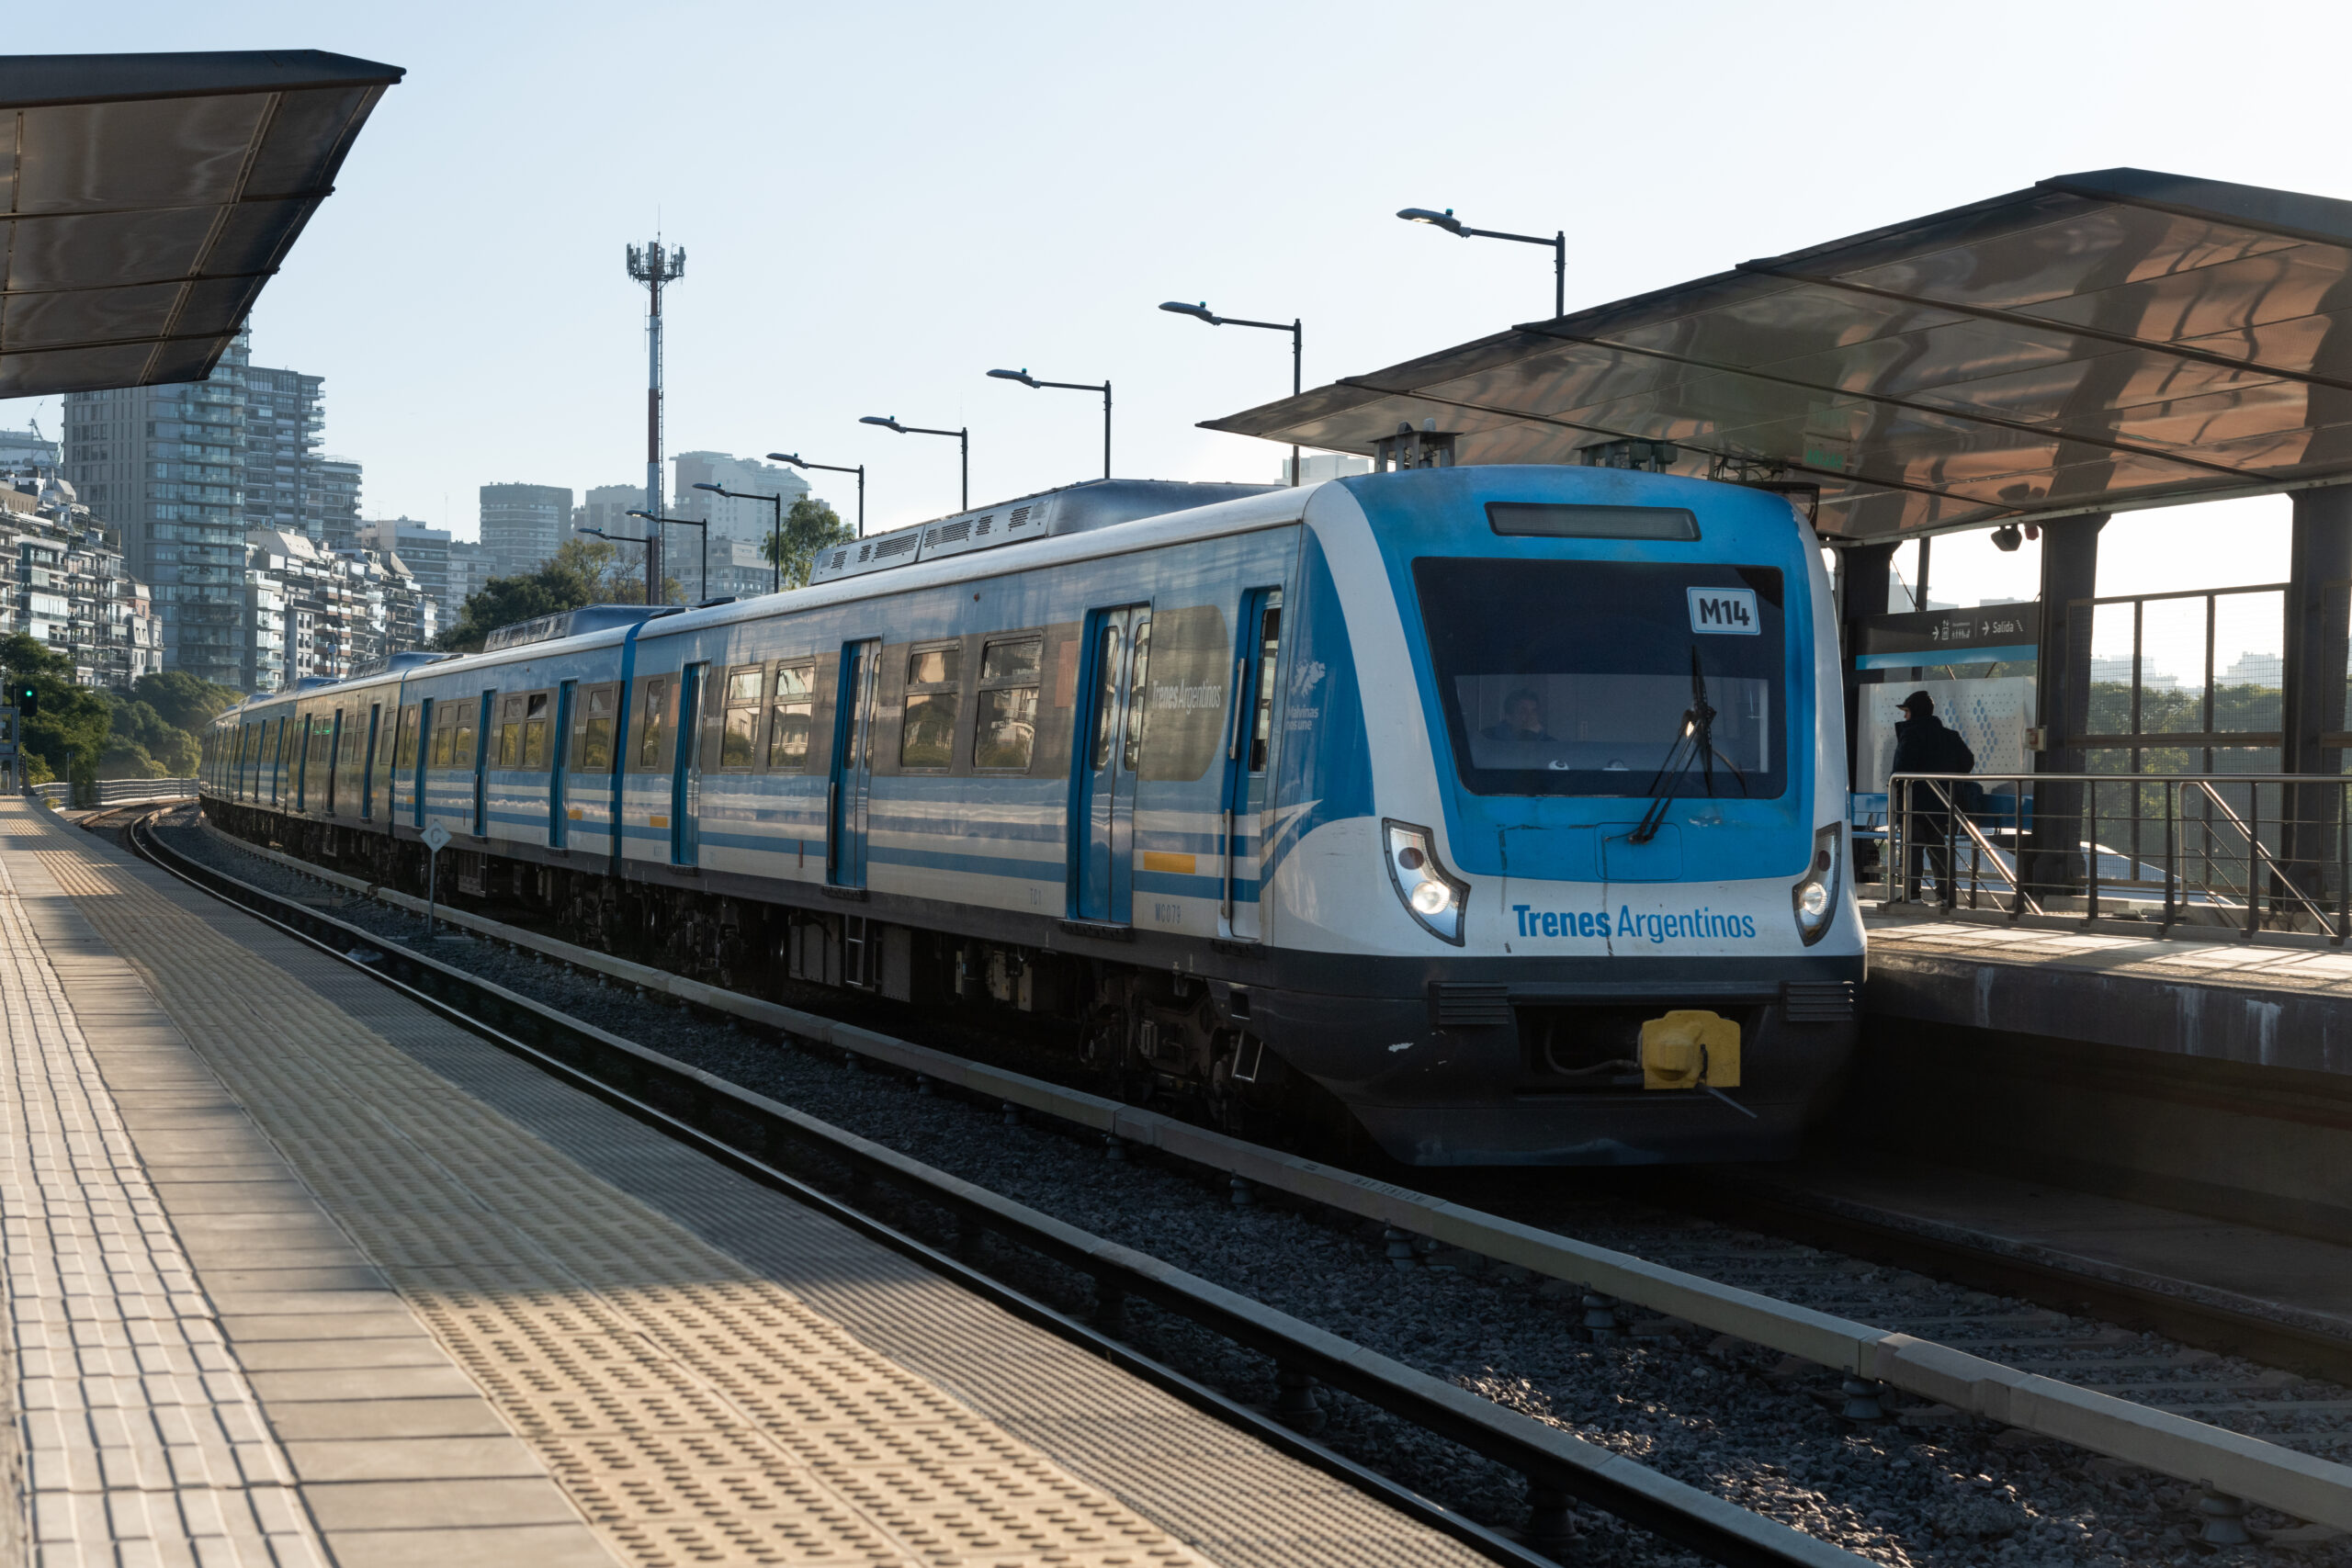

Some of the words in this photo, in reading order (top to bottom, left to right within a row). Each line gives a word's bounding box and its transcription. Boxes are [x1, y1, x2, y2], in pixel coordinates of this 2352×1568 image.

[1699, 598, 1750, 626] M14
[1992, 620, 2014, 634] Salida
[1152, 680, 1179, 709] Trenes
[1177, 678, 1222, 716] Argentinos
[1285, 704, 1319, 718] Malvinas
[1297, 720, 1313, 731] une
[430, 828, 442, 844] C
[1511, 904, 1611, 938] Trenes
[1617, 904, 1757, 943] Argentinos
